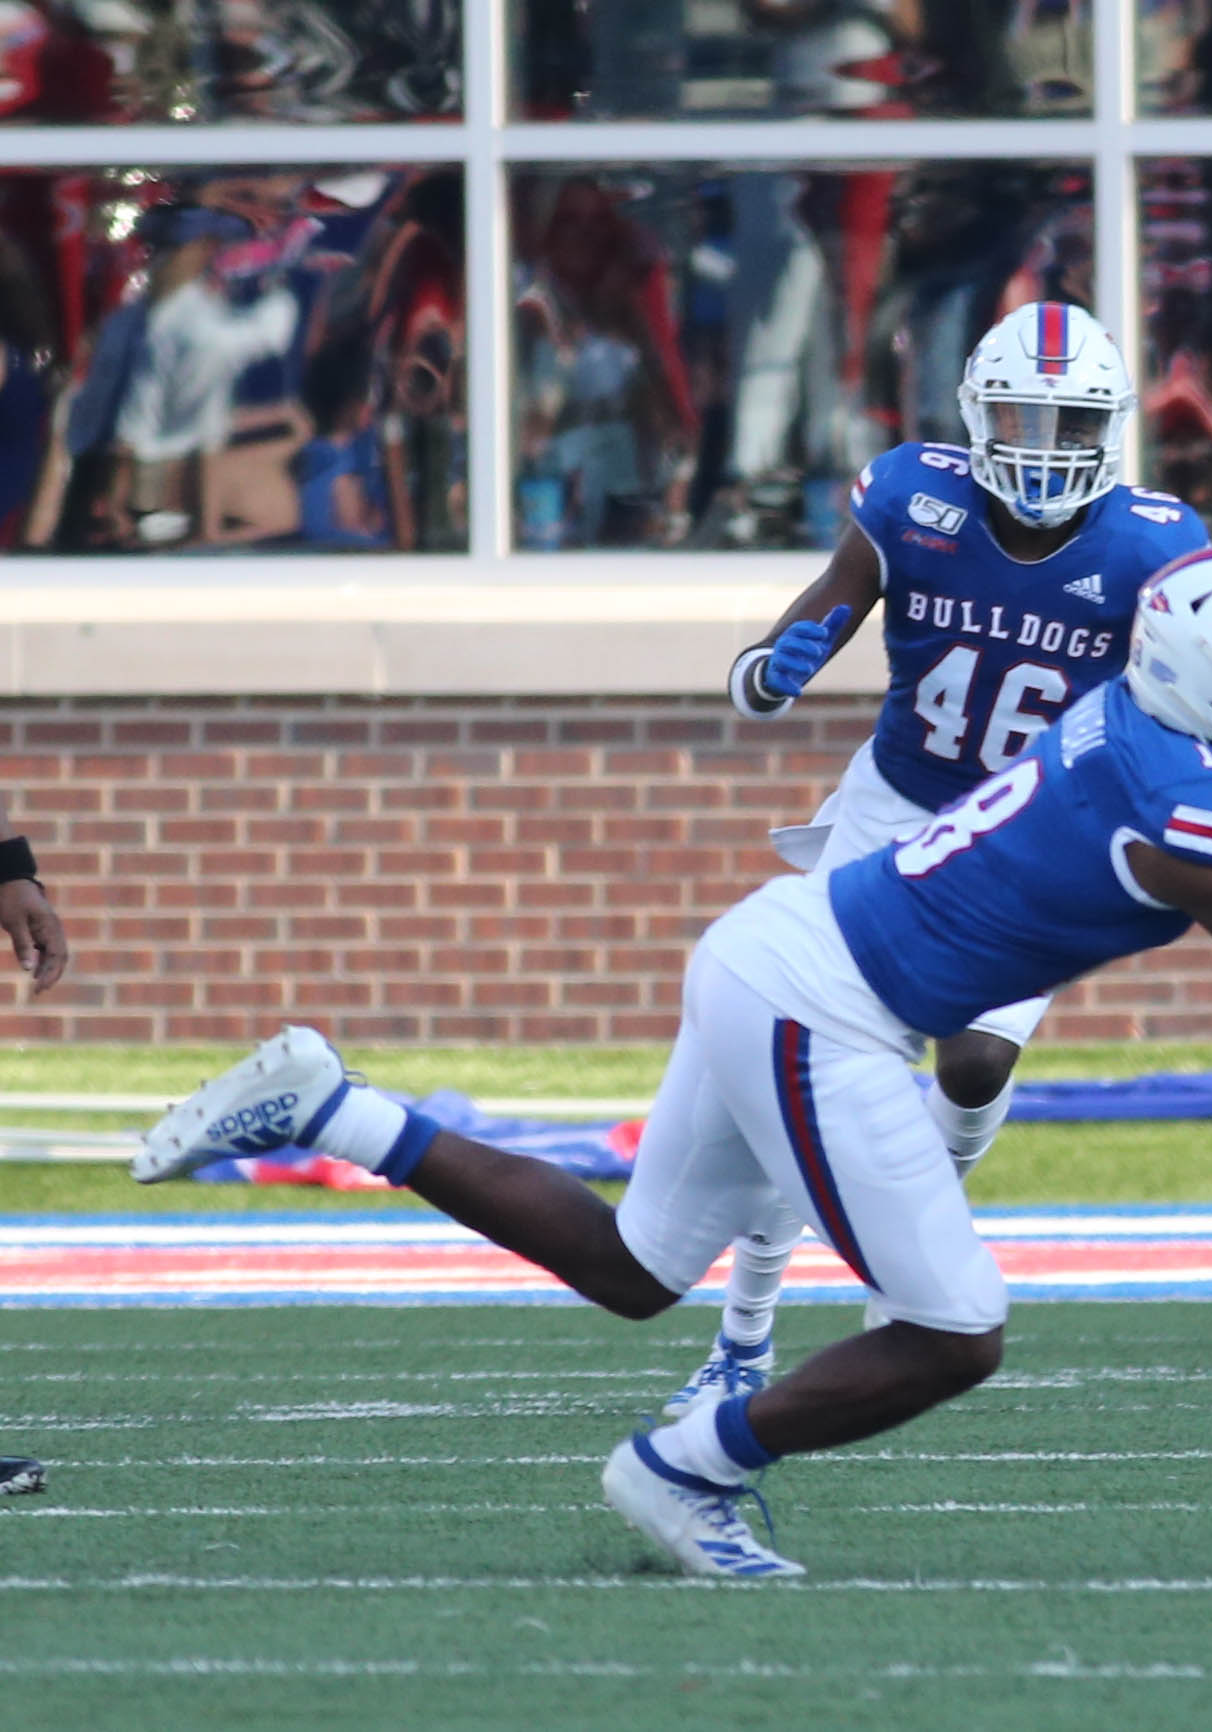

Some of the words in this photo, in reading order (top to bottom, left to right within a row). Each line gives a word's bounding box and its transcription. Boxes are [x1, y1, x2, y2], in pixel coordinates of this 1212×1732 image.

[920, 441, 969, 476] 6
[908, 492, 968, 536] 150
[906, 590, 1114, 659] BULLDOGS
[913, 641, 1071, 776] 46
[893, 756, 1044, 881] 8
[204, 1090, 300, 1143] adidas
